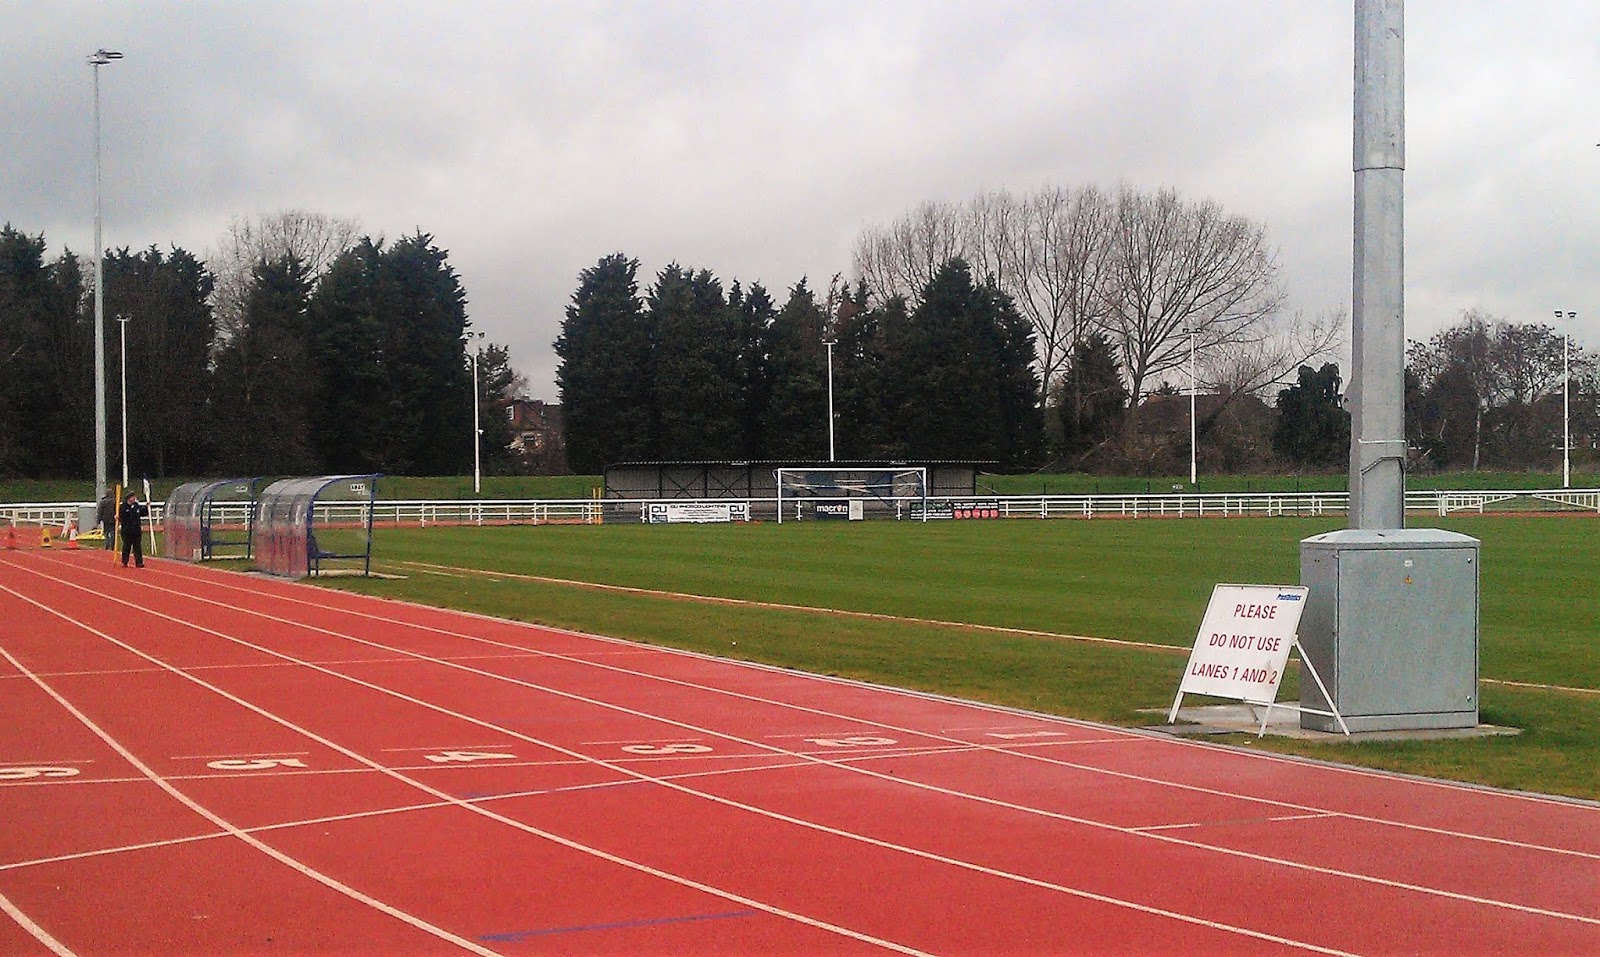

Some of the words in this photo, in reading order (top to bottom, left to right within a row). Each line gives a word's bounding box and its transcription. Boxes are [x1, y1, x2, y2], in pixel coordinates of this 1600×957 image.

[1234, 604, 1277, 619] PLEASE
[1209, 633, 1227, 647] DO
[1229, 635, 1255, 649] NOT
[1256, 636, 1281, 652] USE
[1191, 662, 1229, 679] LANES
[1232, 667, 1239, 680] 1
[1240, 668, 1267, 683] AND
[1269, 670, 1278, 684] 2
[621, 743, 714, 755] 3
[423, 751, 518, 763] 4
[206, 758, 309, 770] 5
